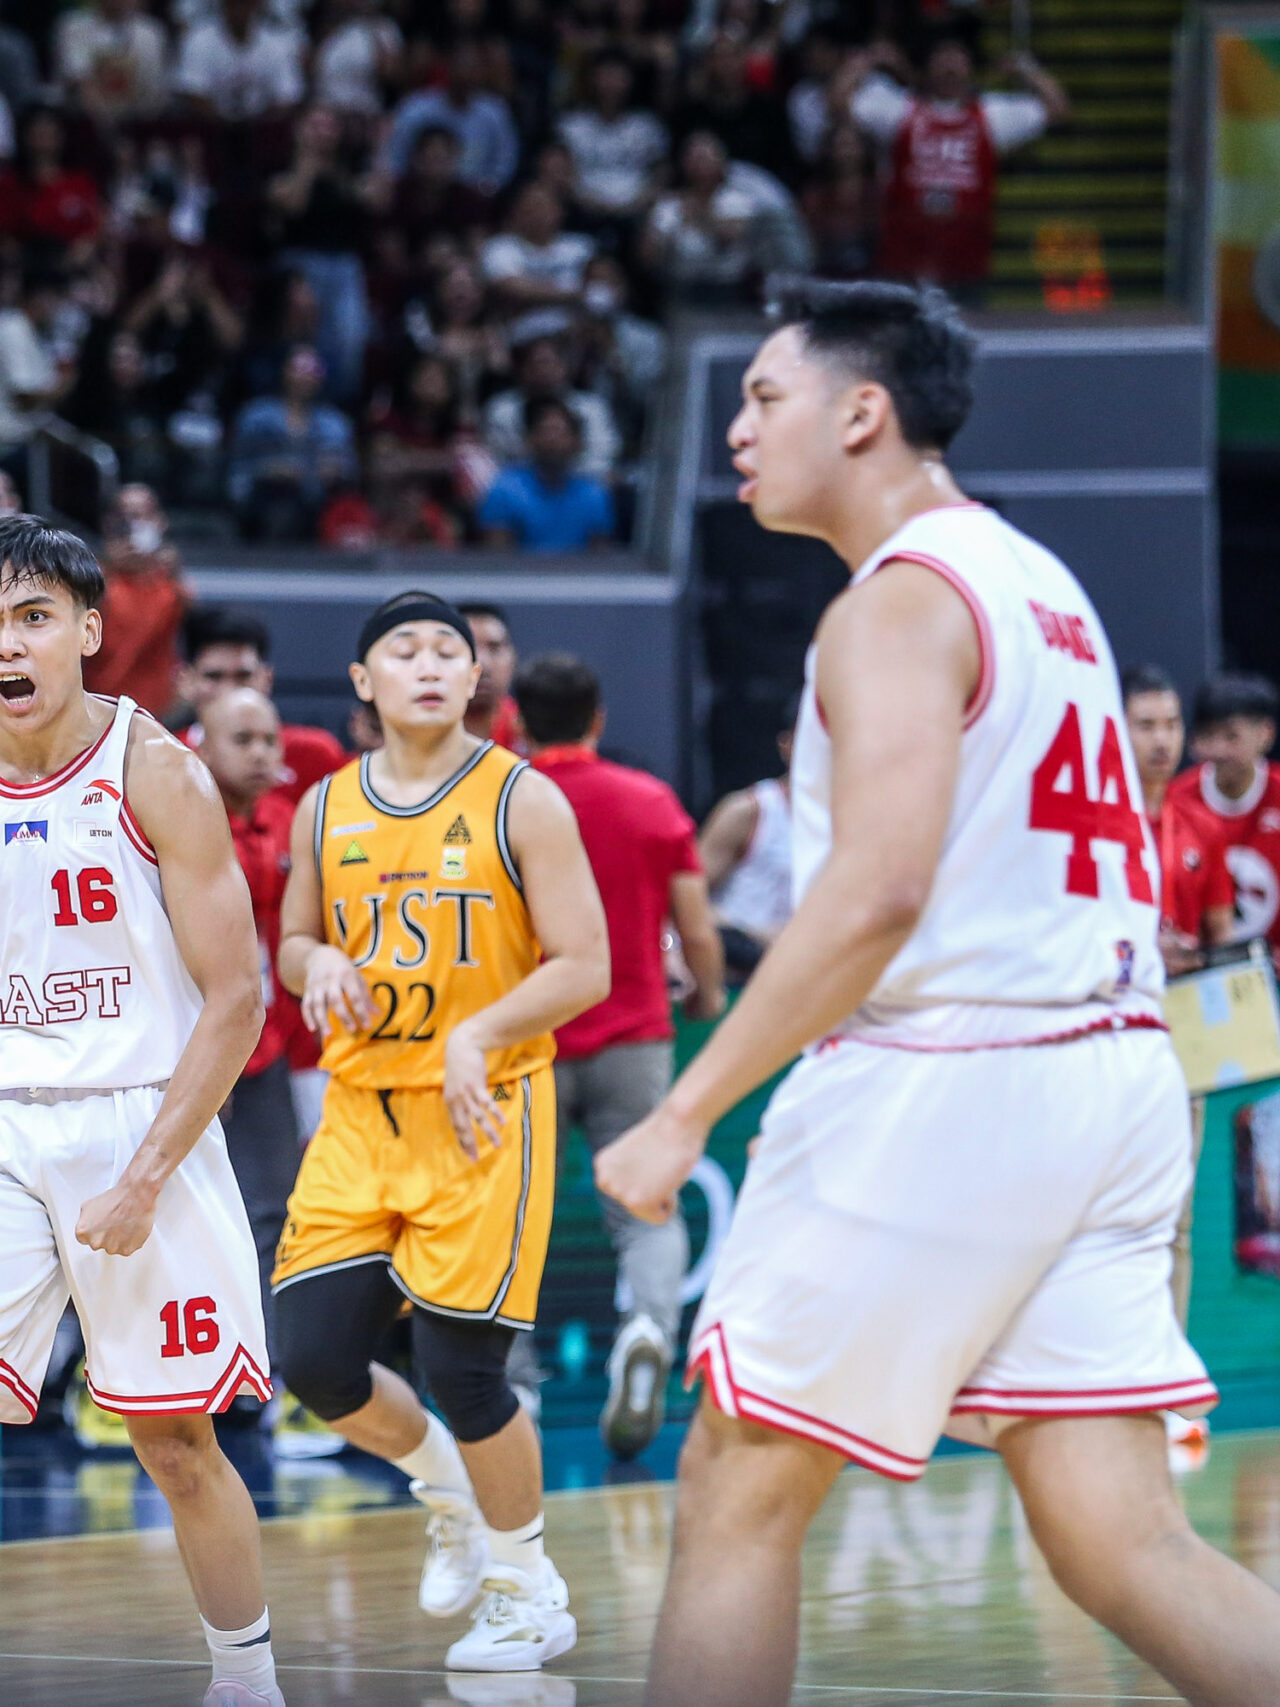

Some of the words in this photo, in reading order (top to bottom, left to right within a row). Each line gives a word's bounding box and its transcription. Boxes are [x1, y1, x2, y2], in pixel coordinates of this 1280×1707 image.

[81, 792, 103, 806] ANTA
[1029, 701, 1156, 906] 44
[51, 867, 118, 926] 16
[333, 887, 496, 970] UST
[371, 982, 436, 1042] 22
[159, 1296, 220, 1358] 16
